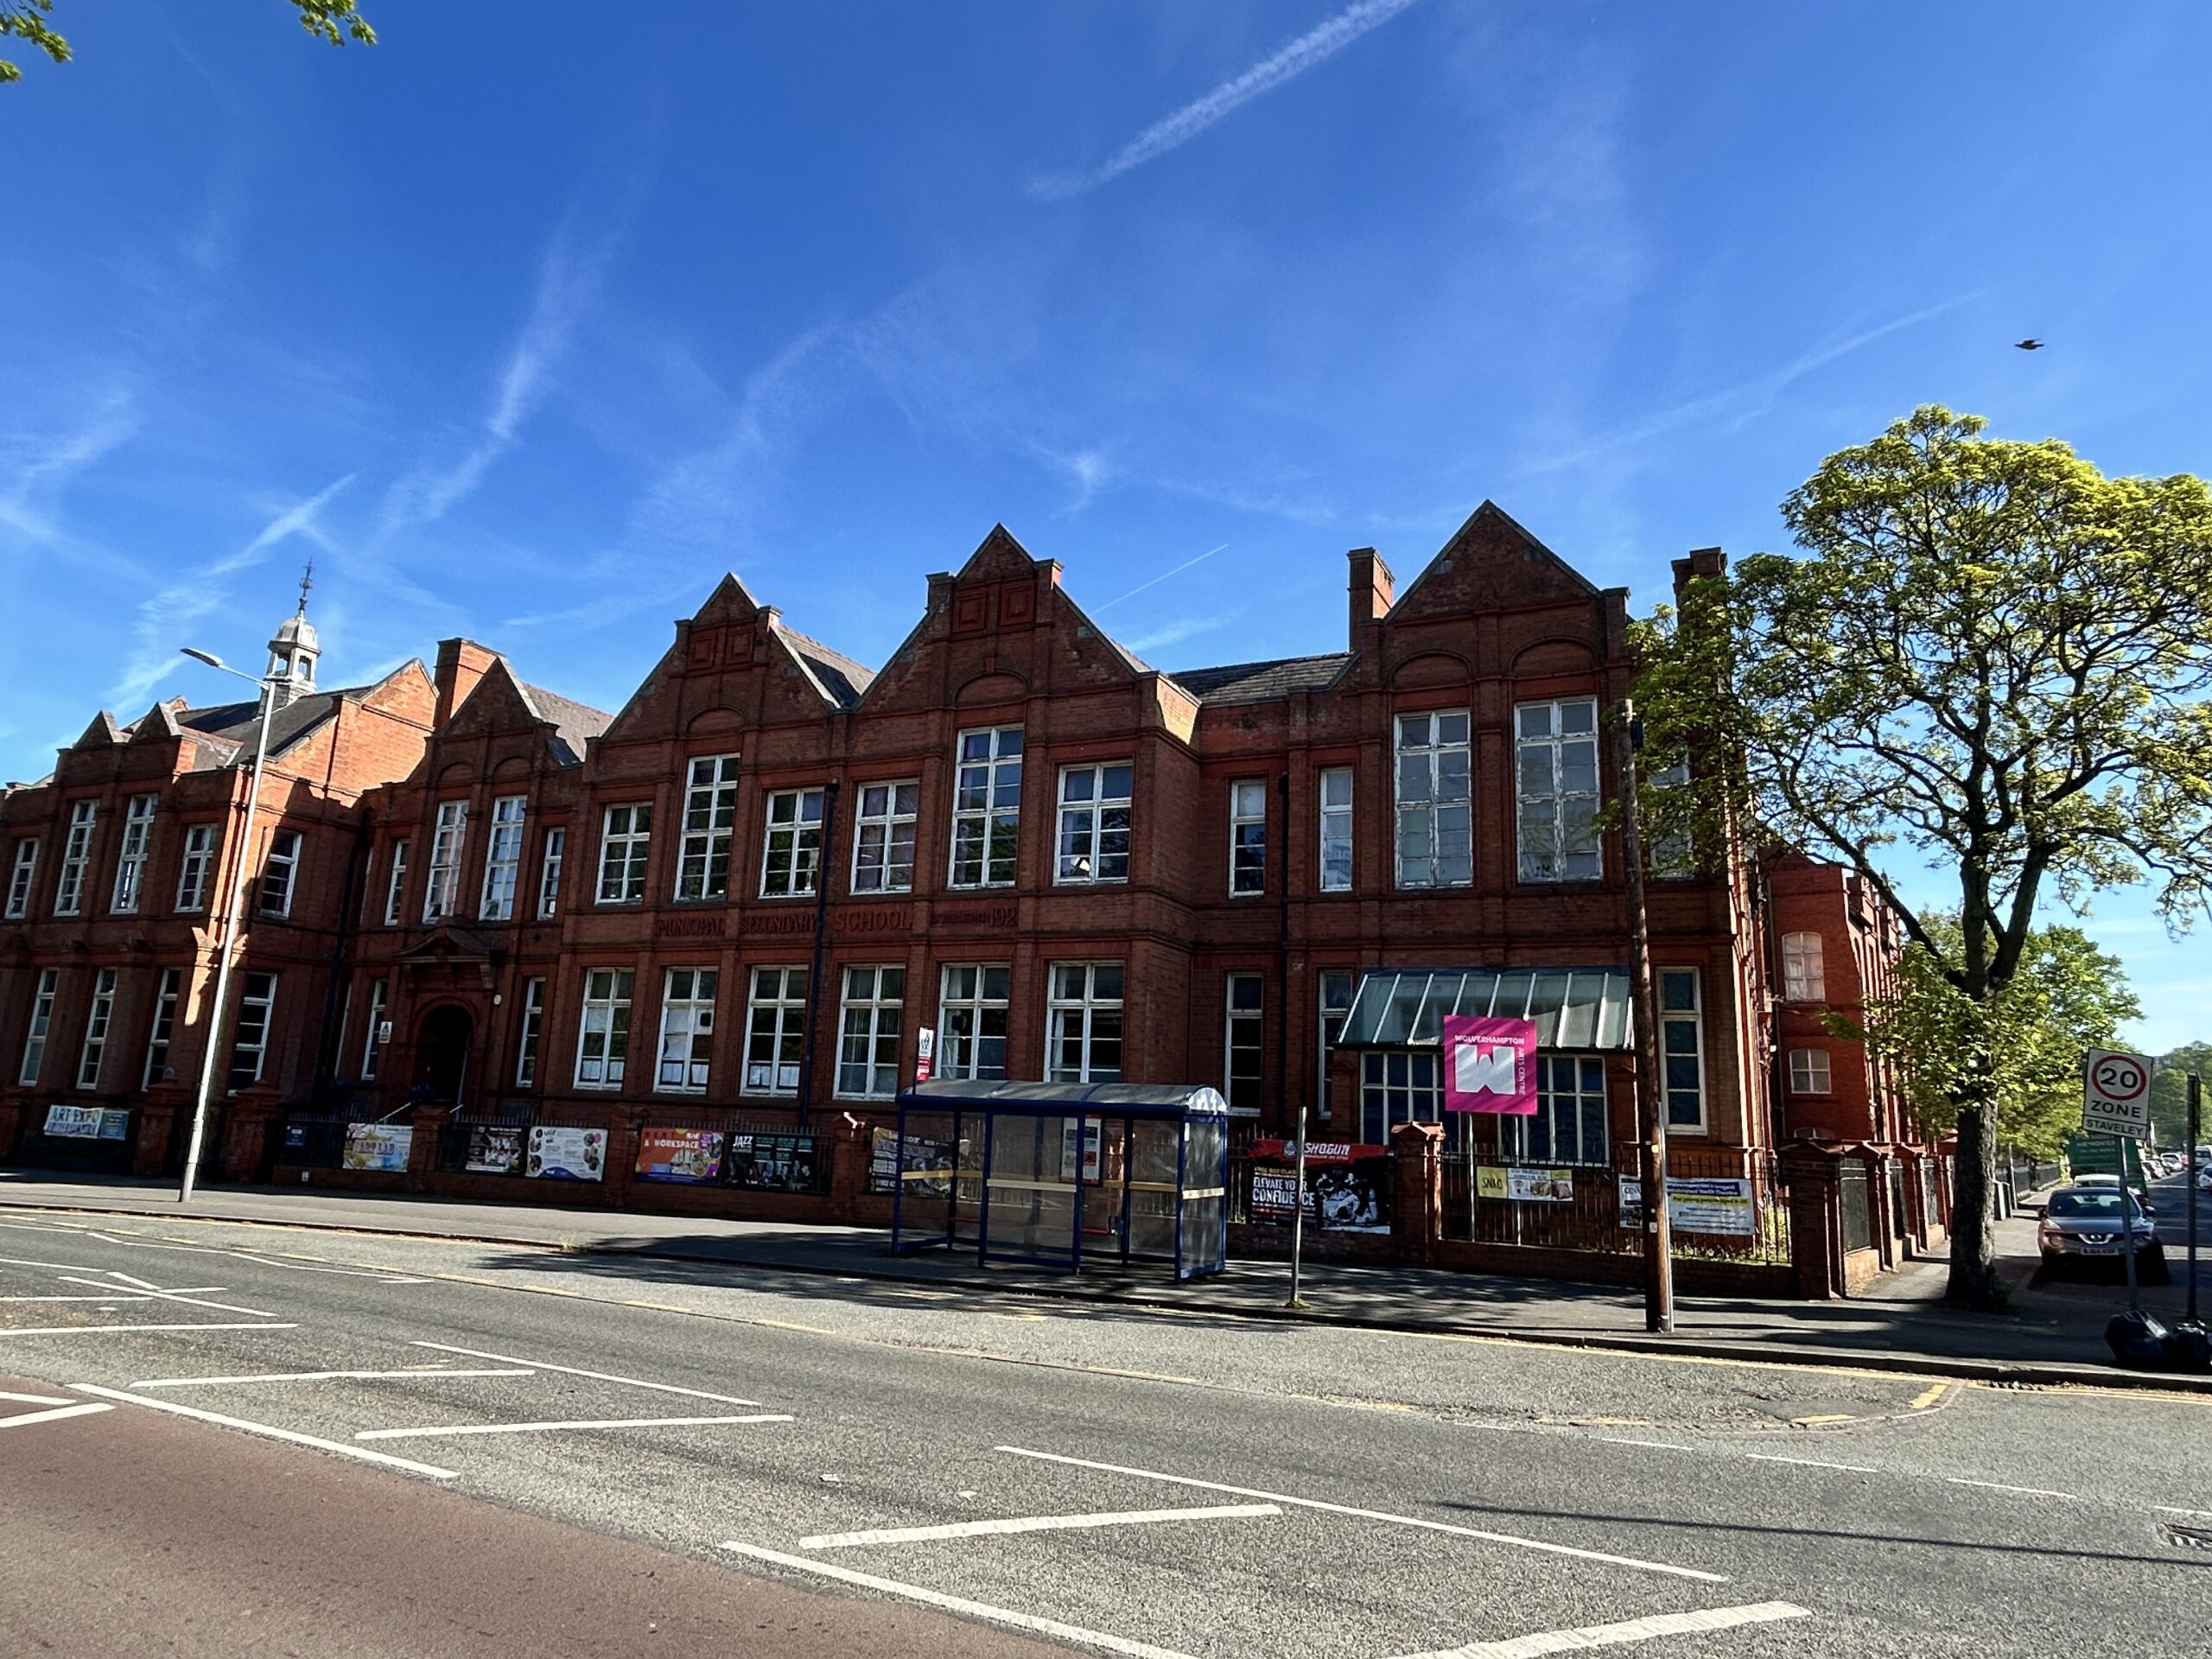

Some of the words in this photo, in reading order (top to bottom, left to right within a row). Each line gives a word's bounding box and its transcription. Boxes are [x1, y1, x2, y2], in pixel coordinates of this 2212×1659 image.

[658, 916, 726, 936] MUNICIPAL
[739, 912, 817, 934] SECONDARY
[835, 911, 912, 931] SCHOOL
[1454, 1034, 1525, 1045] WOLVERHAMPTON
[2101, 1067, 2138, 1089] 20
[2091, 1100, 2142, 1118] ZONE
[2087, 1119, 2144, 1136] STAVELEY
[654, 1139, 699, 1149] WORKSPACE
[733, 1135, 753, 1147] JAZZ
[1304, 1142, 1351, 1155] SHOGUN
[1253, 1176, 1284, 1190] ELEVATE
[1285, 1179, 1307, 1192] YOR
[1252, 1187, 1315, 1206] CONFIDECE
